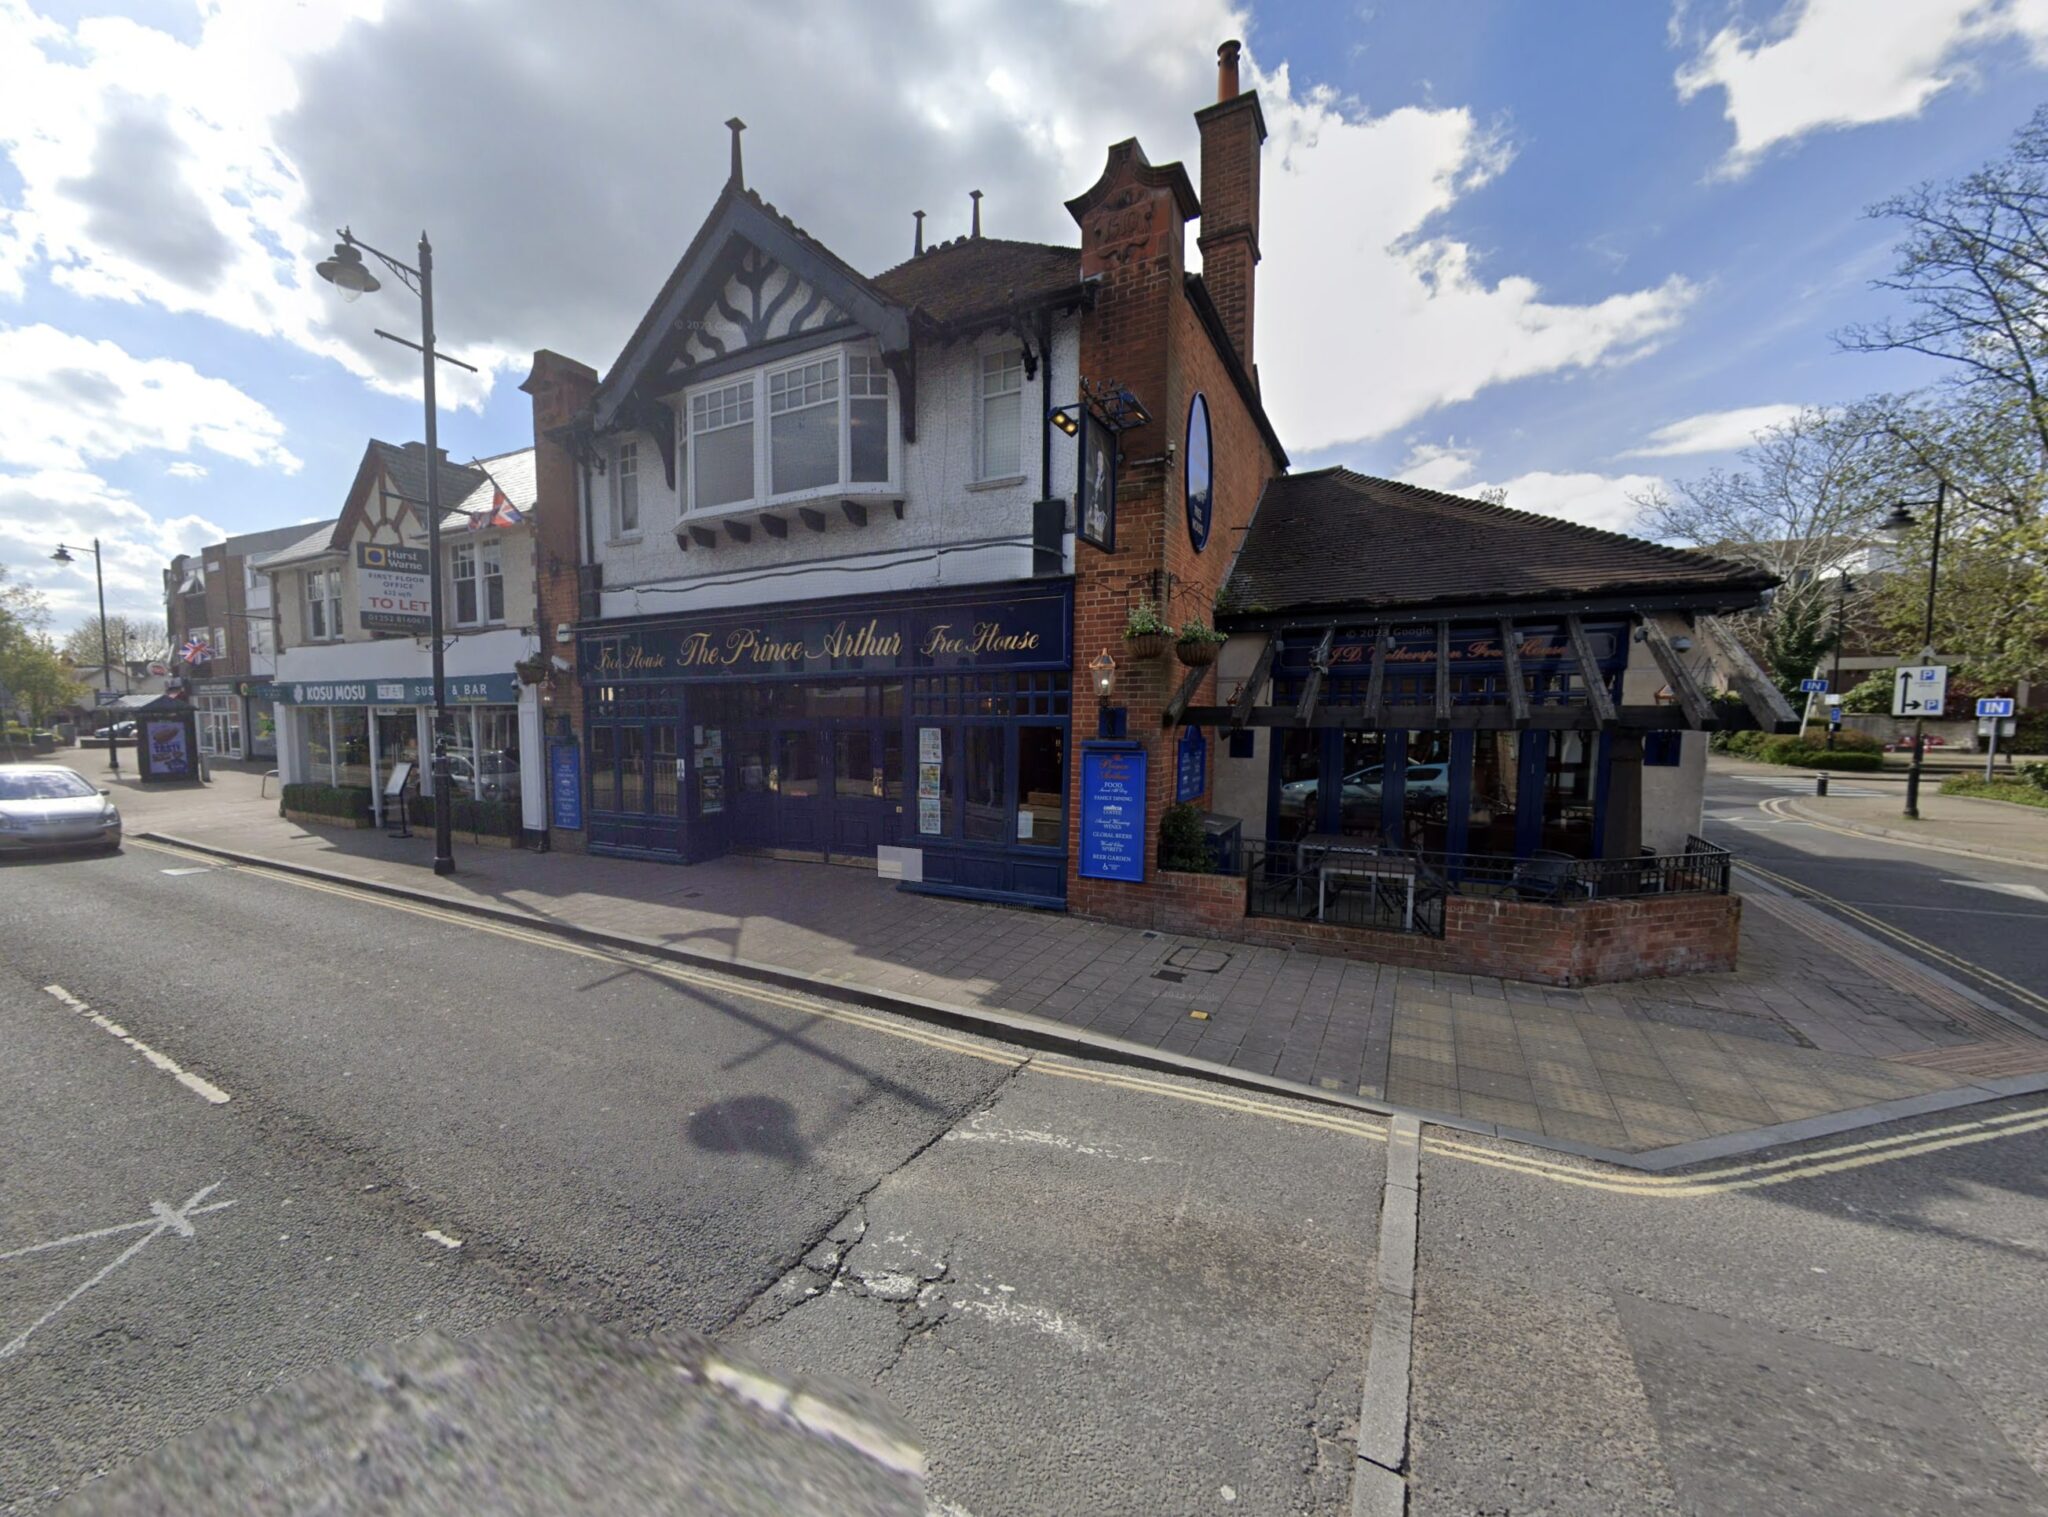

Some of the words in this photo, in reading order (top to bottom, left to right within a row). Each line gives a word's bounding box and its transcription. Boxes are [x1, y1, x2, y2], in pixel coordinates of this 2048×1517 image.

[387, 549, 417, 561] Hurst
[388, 559, 423, 570] Warne
[368, 572, 393, 581] FIRST
[395, 575, 425, 584] FLOOR
[382, 581, 414, 590] OFFICE
[368, 597, 394, 609] TO
[399, 599, 430, 613] LET
[676, 631, 721, 666] The
[720, 627, 804, 665] Prince
[805, 618, 904, 660] Arthur
[920, 623, 966, 656] Free
[965, 621, 1040, 656] House
[595, 647, 621, 671] Free
[622, 646, 666, 672] House
[451, 685, 458, 697] &
[464, 684, 488, 696] BAR
[1807, 681, 1821, 691] IN
[306, 685, 333, 701] KOSU
[335, 684, 367, 701] MOSU
[1985, 701, 2005, 714] IN
[1104, 781, 1122, 789] FOOD
[1092, 831, 1115, 839] GLOBAL
[1107, 855, 1131, 863] GARDEN
